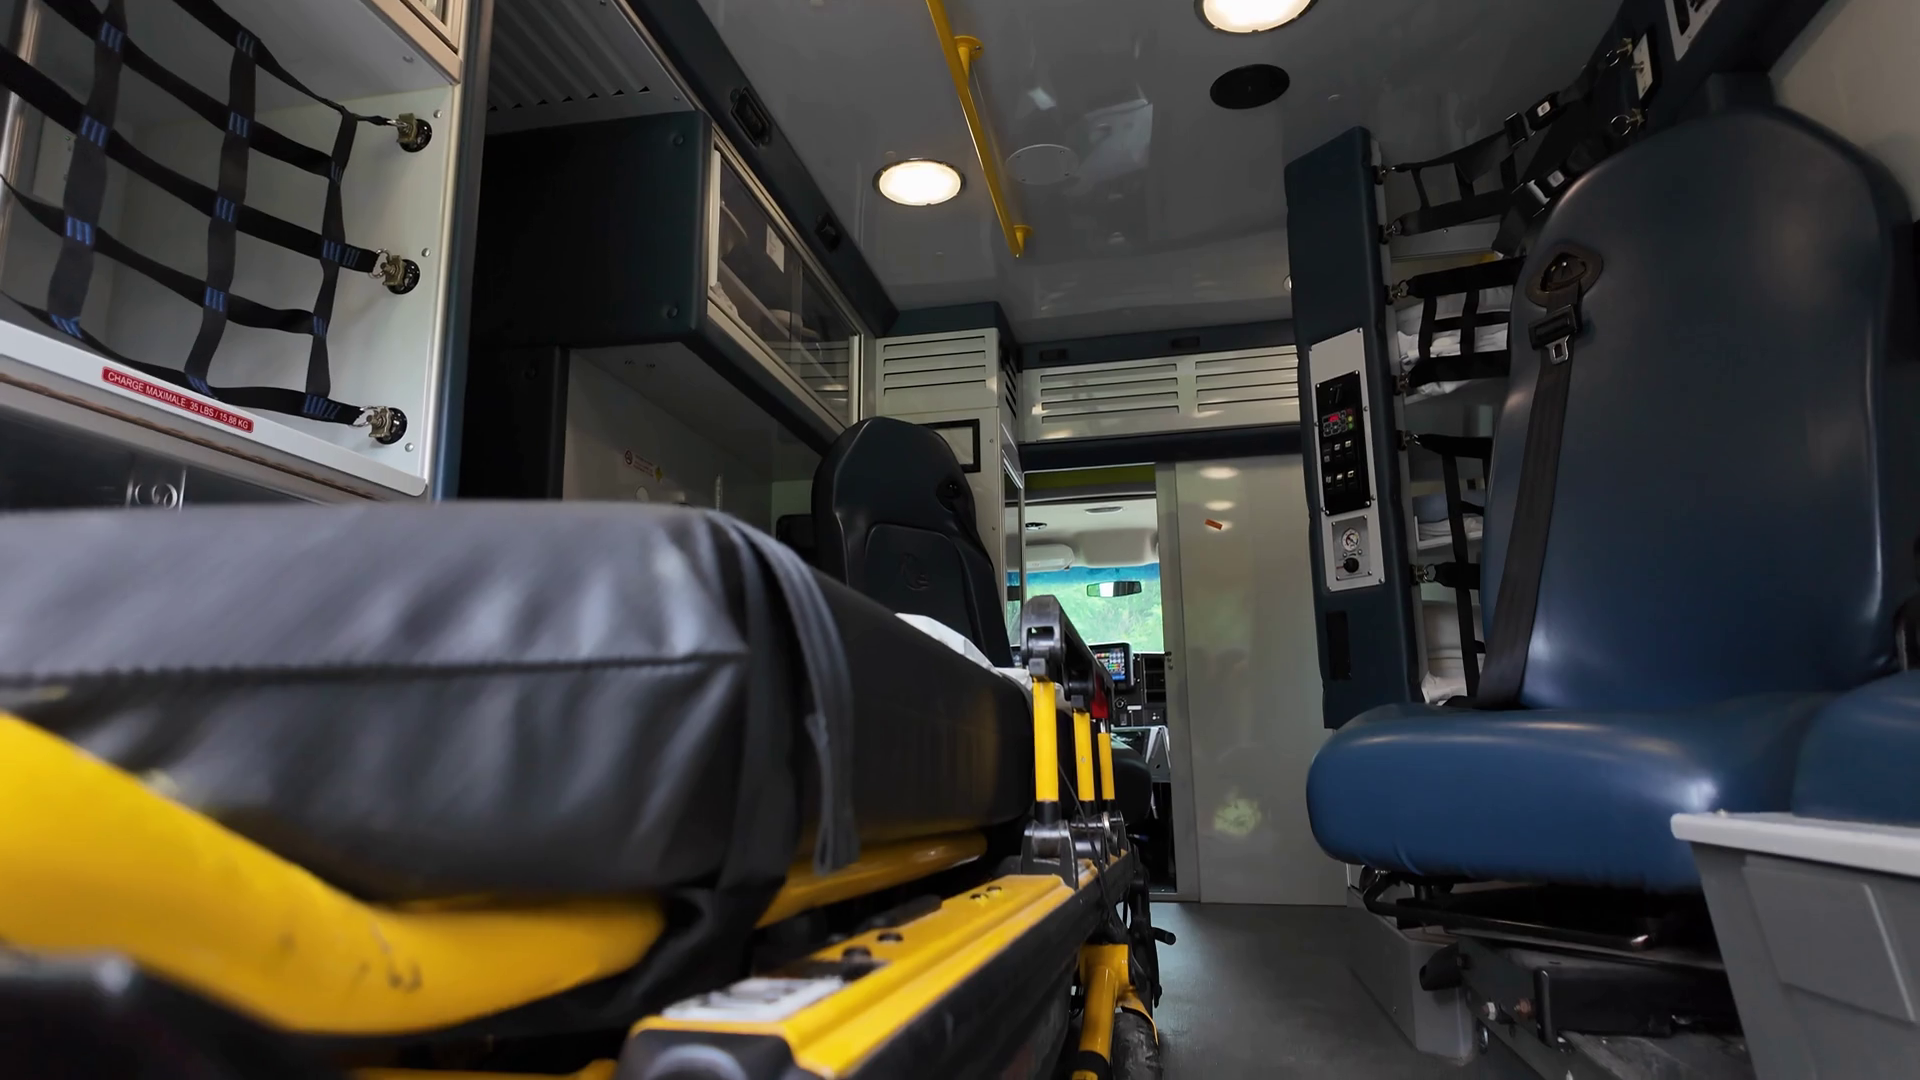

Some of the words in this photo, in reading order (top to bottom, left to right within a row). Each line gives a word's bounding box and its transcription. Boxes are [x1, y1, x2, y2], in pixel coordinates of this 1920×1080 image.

[108, 372, 144, 392] CHARGE
[189, 400, 199, 412] 35
[200, 405, 214, 417] LBS
[238, 418, 249, 429] KG
